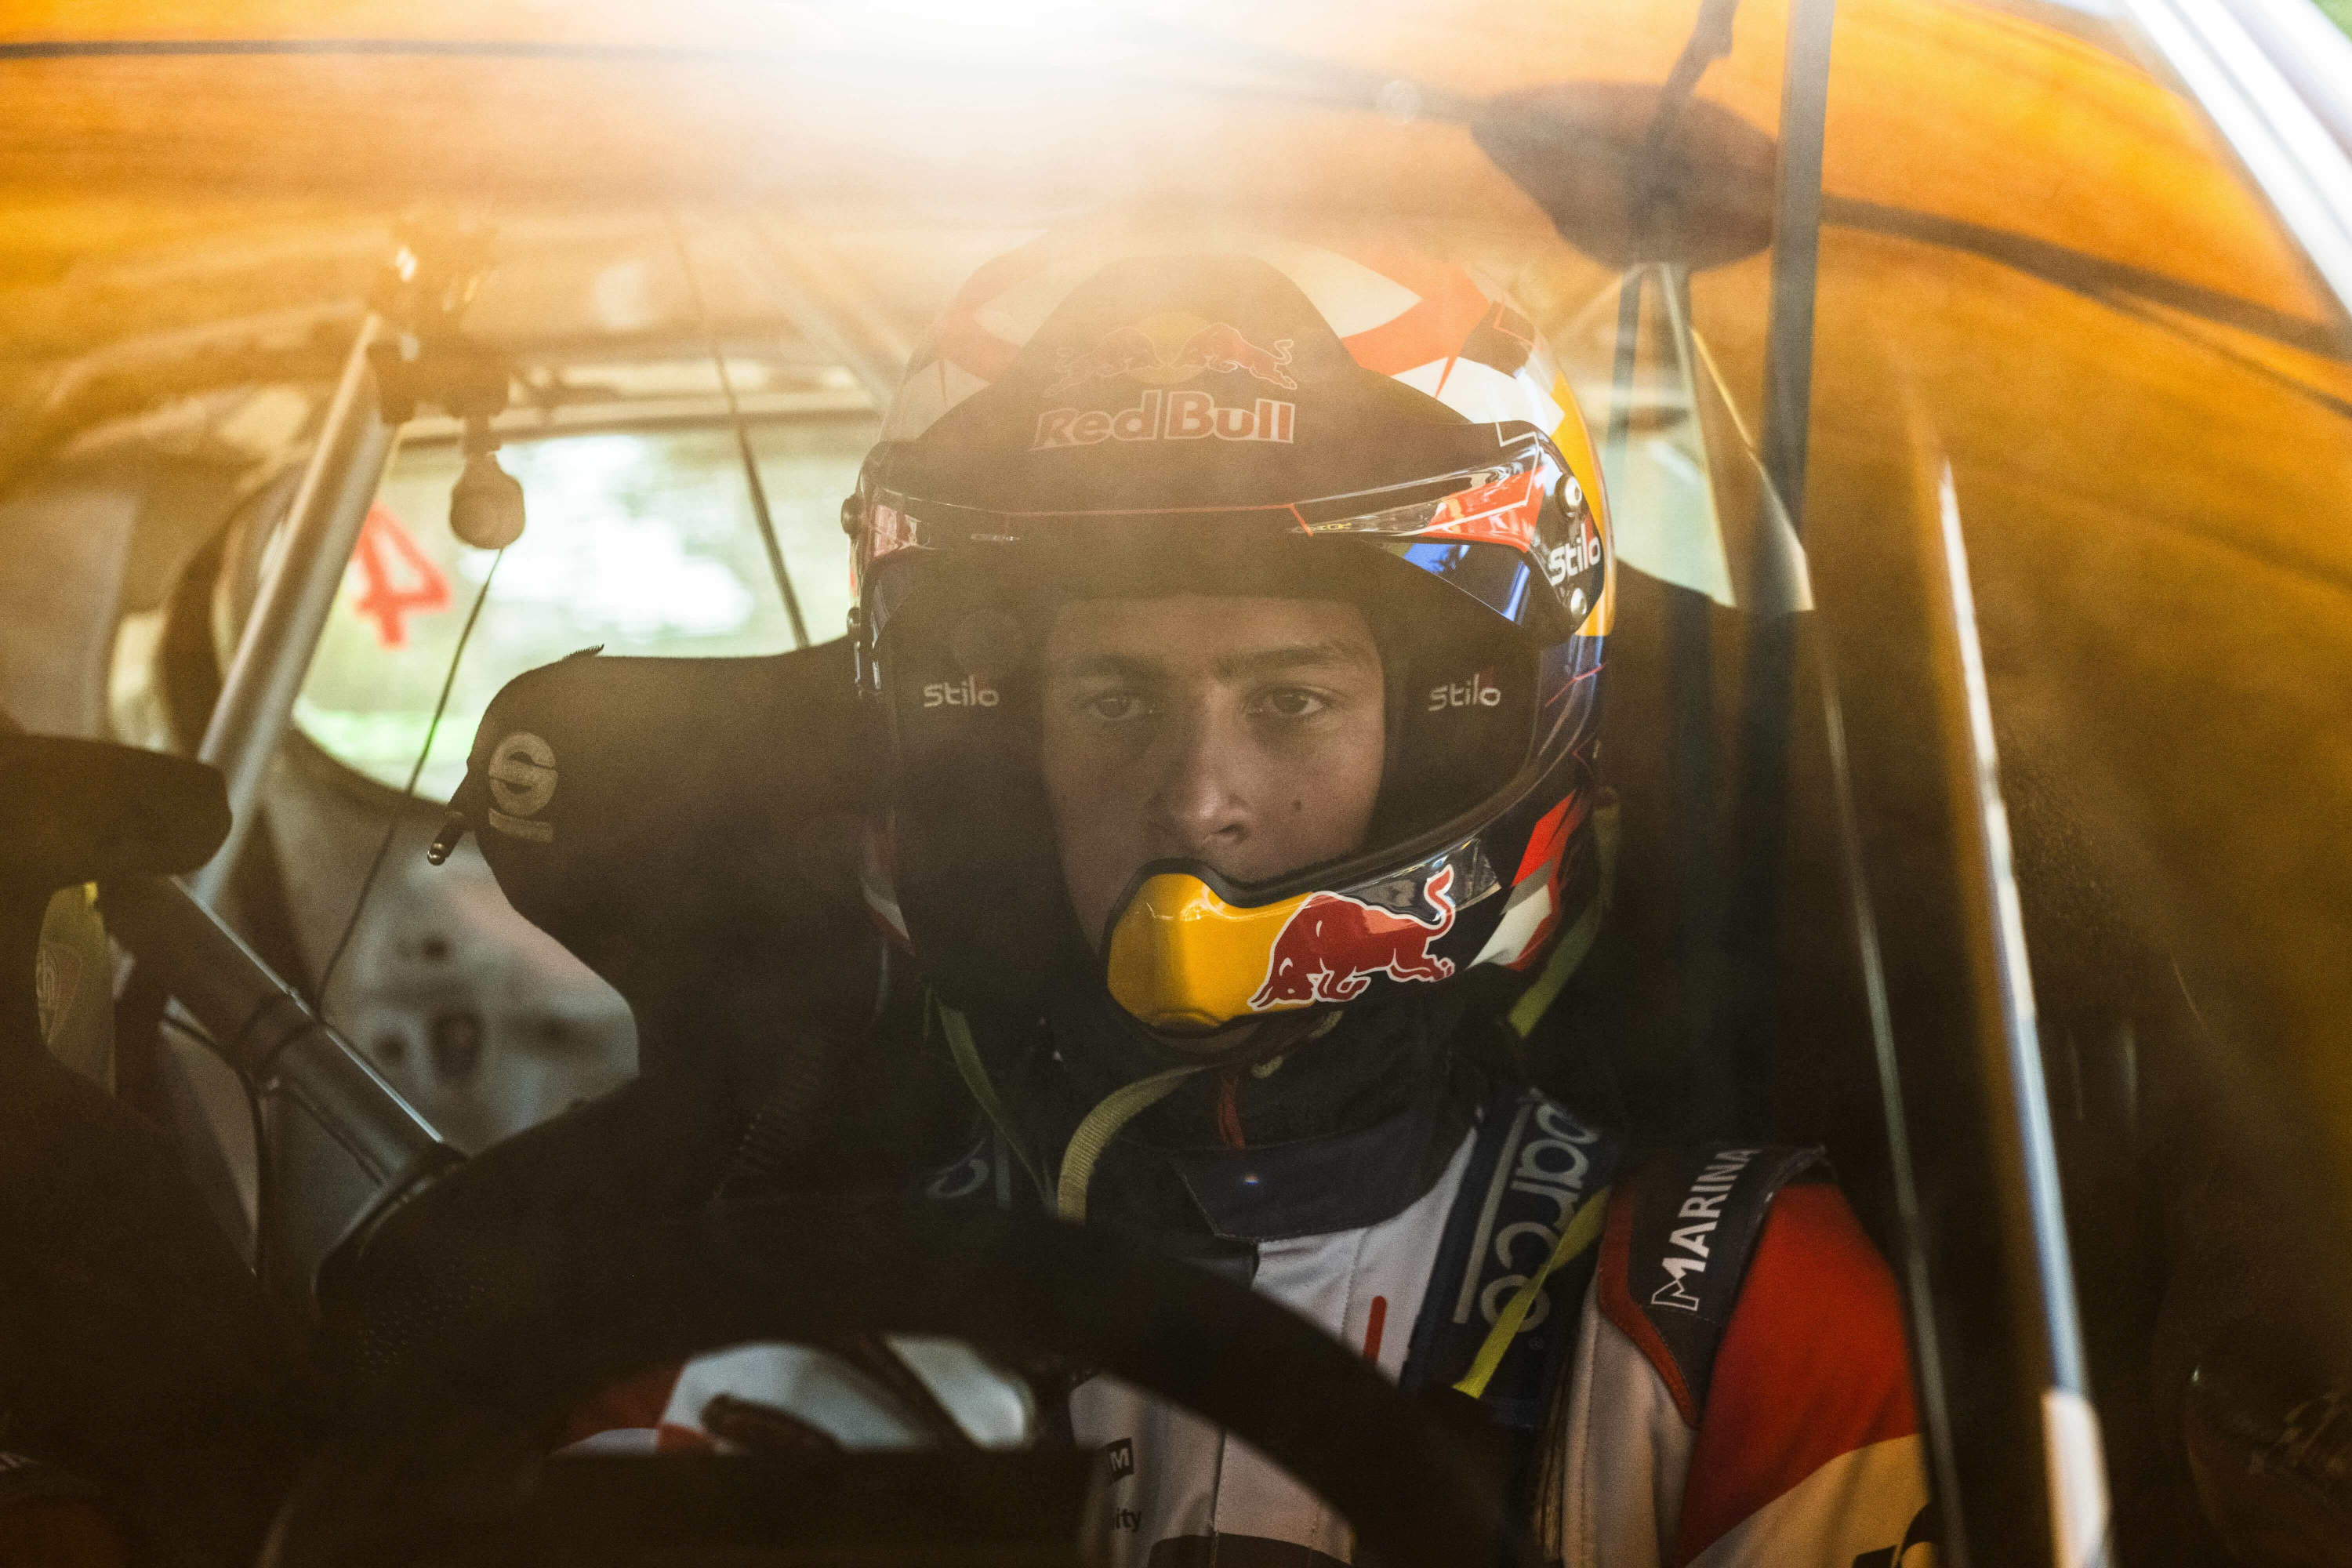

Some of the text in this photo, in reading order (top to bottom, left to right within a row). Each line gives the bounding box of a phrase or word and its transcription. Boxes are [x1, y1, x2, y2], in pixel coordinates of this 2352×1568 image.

[1028, 390, 1296, 451] Red Bull
[1548, 522, 1601, 586] stilo
[924, 674, 1000, 707] stilo
[1428, 673, 1501, 711] stilo
[1651, 1149, 1764, 1312] MARINA
